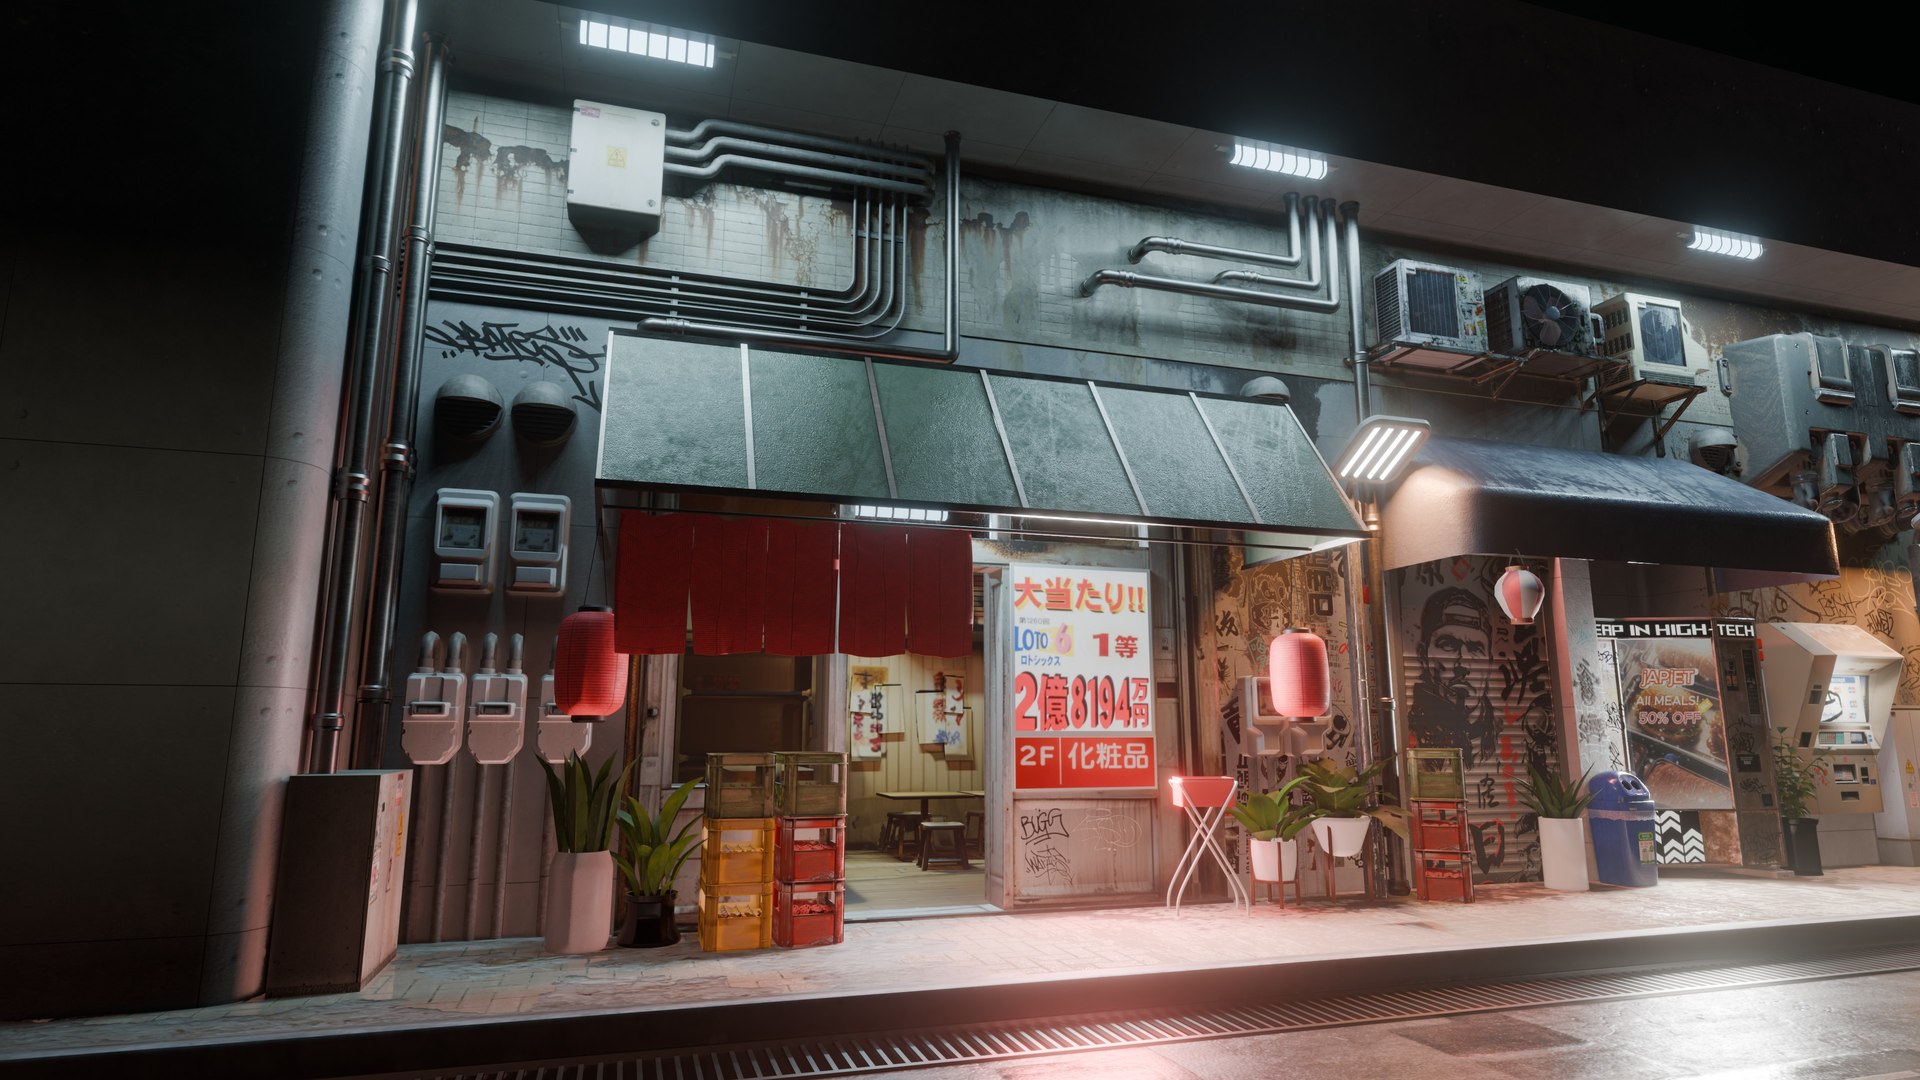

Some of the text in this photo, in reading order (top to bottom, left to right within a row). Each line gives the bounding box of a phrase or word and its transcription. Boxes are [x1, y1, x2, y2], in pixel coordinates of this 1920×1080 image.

[1014, 577, 1146, 613] 大当たり!!
[1014, 623, 1073, 655] LOTO 6
[1629, 623, 1651, 637] IN
[1021, 655, 1061, 666] ロトシックス
[1014, 671, 1149, 732] 2億8194万円
[1636, 695, 1700, 706] All MEALS!
[1638, 711, 1669, 725] 50%
[1671, 711, 1702, 725] OFF
[1020, 745, 1055, 766] 2F
[1067, 741, 1149, 770] 化粧品
